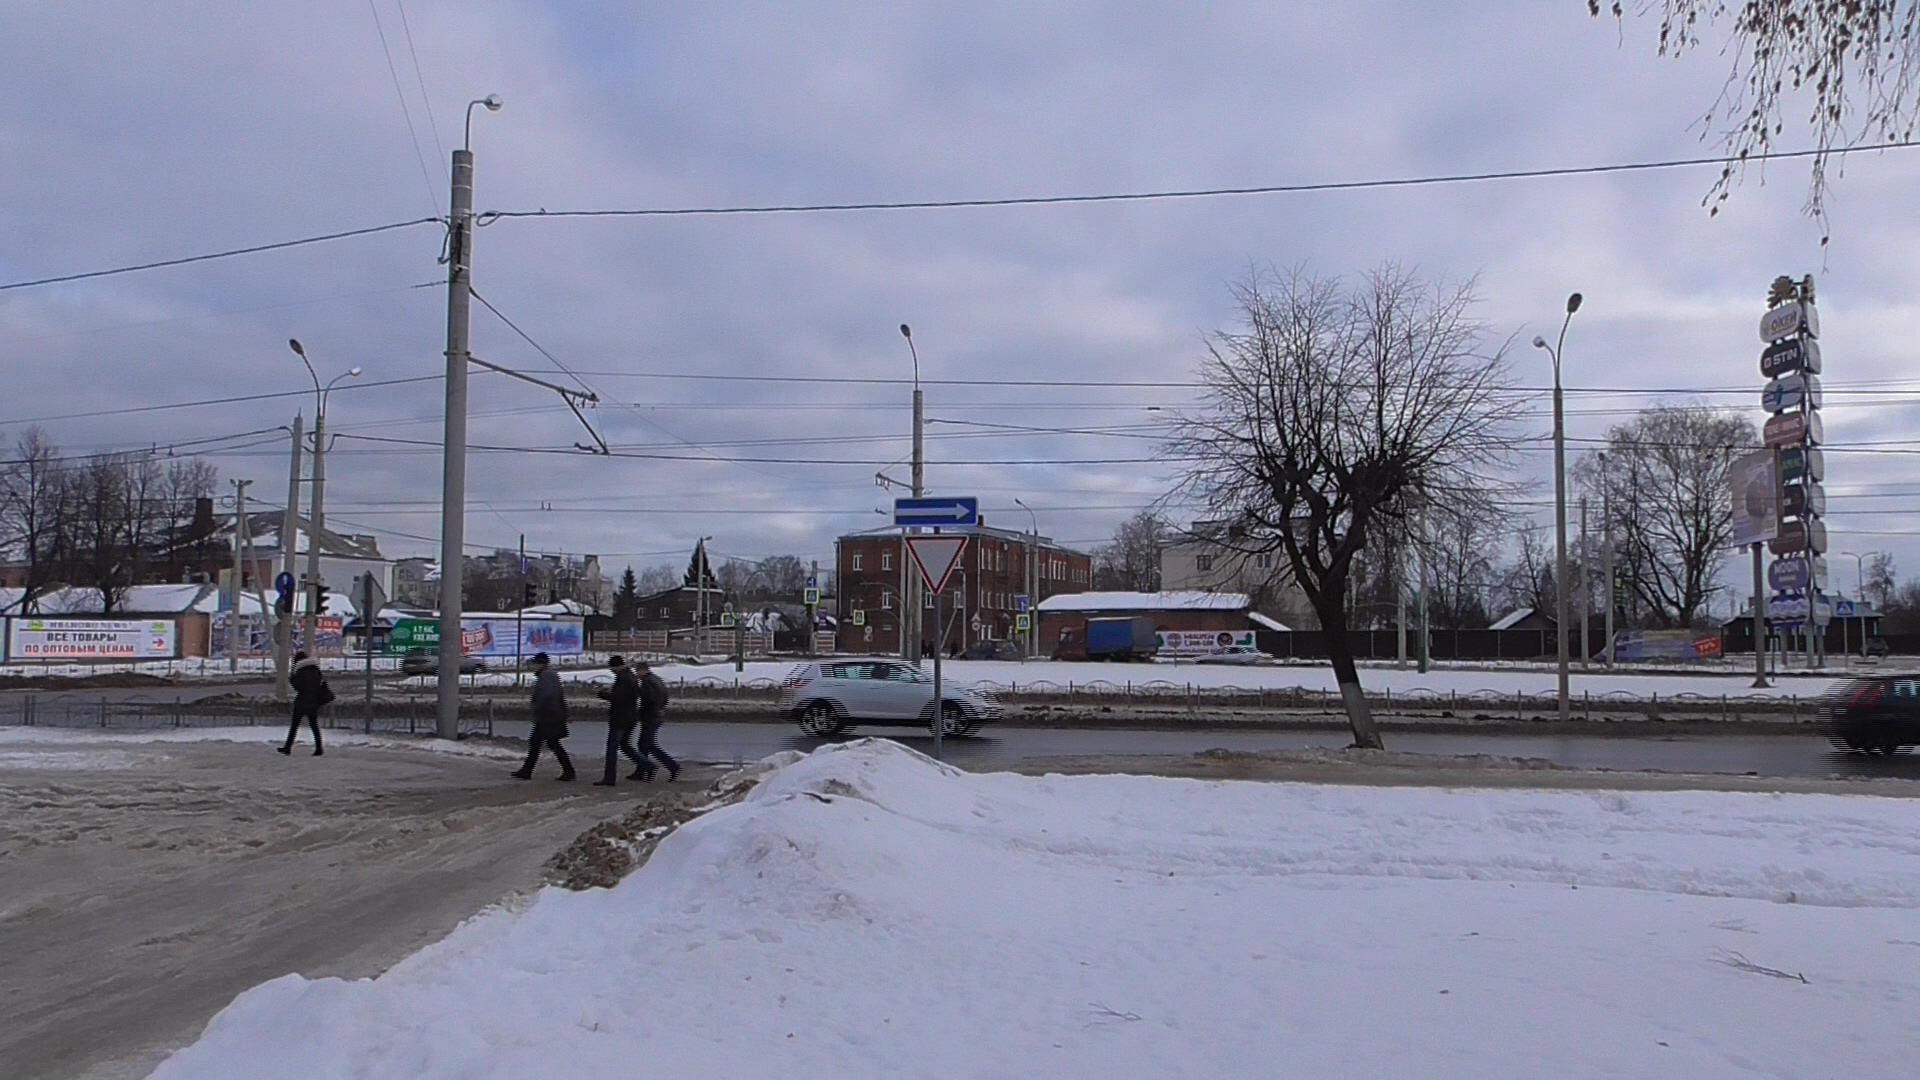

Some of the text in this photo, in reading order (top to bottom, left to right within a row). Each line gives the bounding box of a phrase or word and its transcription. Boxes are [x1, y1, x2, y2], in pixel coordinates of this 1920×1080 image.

[47, 633, 117, 642] ВСЕ ТОВАРЫ
[25, 645, 134, 654] ПО ОПТОВЫМ ЦЕНАМ
